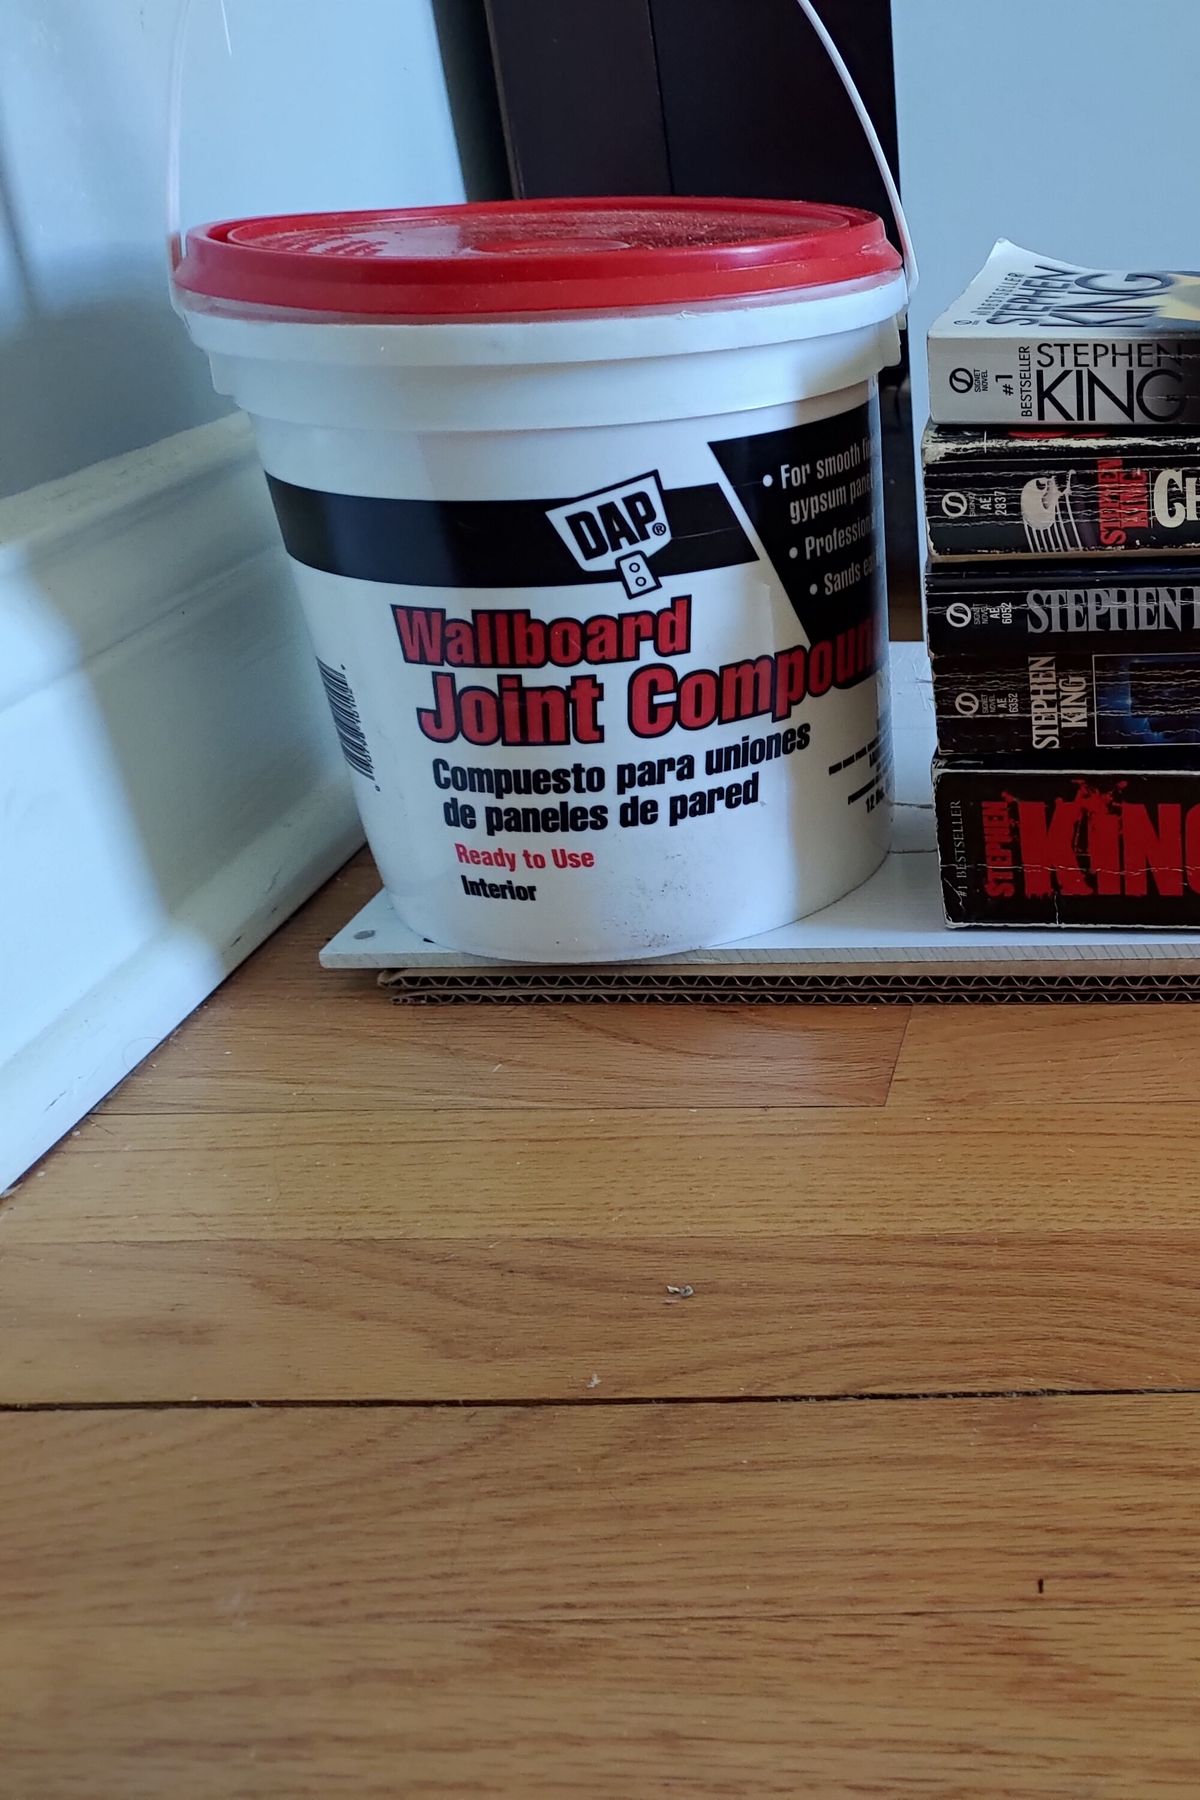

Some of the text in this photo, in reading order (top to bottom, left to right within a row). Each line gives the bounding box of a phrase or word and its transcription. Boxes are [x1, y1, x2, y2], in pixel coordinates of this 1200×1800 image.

[986, 265, 1081, 326] STEPHEN
[1039, 273, 1175, 327] KING
[1037, 343, 1183, 367] STEPHEN
[996, 374, 1014, 396] #1
[1019, 346, 1033, 417] BESTSELLER
[1037, 368, 1187, 423] KING
[780, 462, 811, 490] For
[816, 442, 861, 480] smooth
[790, 482, 847, 525] gypsum
[979, 497, 992, 511] AE
[994, 491, 1007, 516] 2837
[1097, 457, 1127, 546] STEPHEN
[1120, 471, 1148, 529] KING
[824, 562, 861, 596] Sands
[391, 594, 692, 668] Wallboard
[989, 607, 1000, 619] AE
[1001, 602, 1013, 624] 6052
[1027, 587, 1182, 633] STEPHEN
[416, 671, 604, 746] Joint
[997, 697, 1007, 709] AE
[1008, 693, 1019, 713] 6352
[1028, 655, 1060, 750] STEPHEN
[1058, 675, 1088, 728] KING
[432, 758, 605, 800] Compuesto
[617, 753, 695, 795] para
[705, 722, 811, 775] uniones
[444, 772, 759, 836] de paneles de pared
[454, 843, 595, 872] Ready to Use
[950, 799, 968, 898] #1 BESTSELLER
[981, 800, 1015, 898] STEPHEN
[461, 875, 537, 901] Interior
